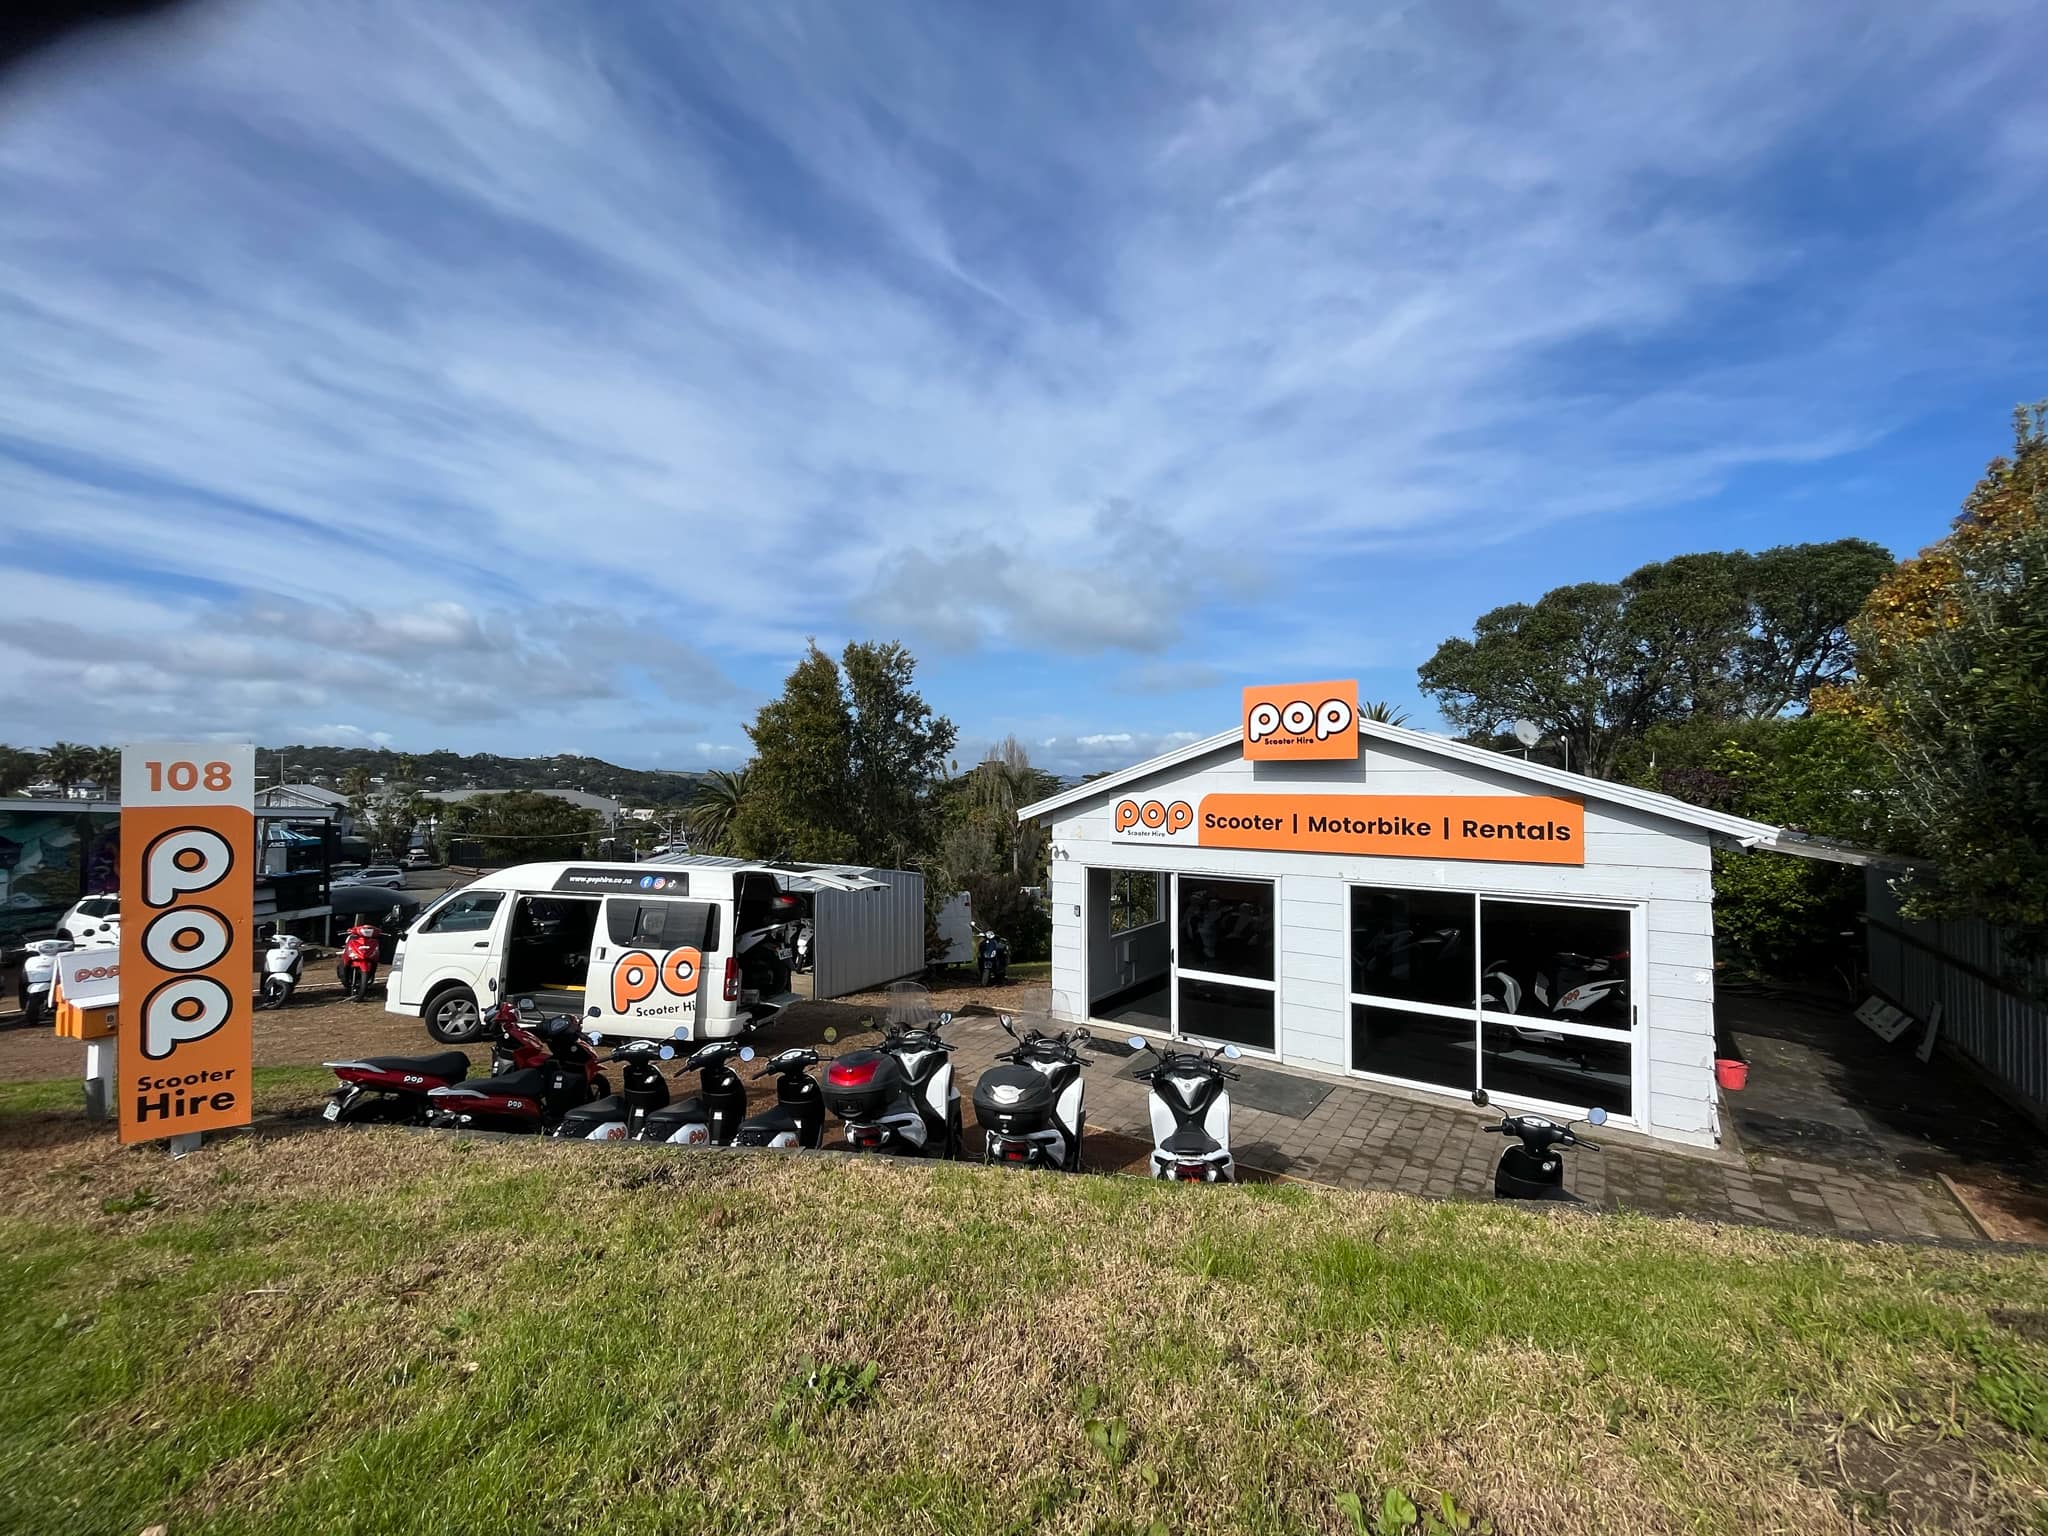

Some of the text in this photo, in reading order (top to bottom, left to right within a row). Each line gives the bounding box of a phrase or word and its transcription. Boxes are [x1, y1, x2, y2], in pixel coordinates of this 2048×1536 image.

[1248, 698, 1352, 743] pop
[1264, 736, 1314, 745] Scooter Hire
[145, 761, 232, 792] 108
[1115, 799, 1194, 835] pop
[1205, 813, 1283, 831] Scooter
[1308, 816, 1431, 836] Motorbike
[1462, 820, 1571, 841] Rentals
[636, 1004, 680, 1017] Scooter
[137, 1068, 236, 1093] Scooter
[403, 1075, 424, 1084] pop
[137, 1088, 236, 1123] Hire
[507, 1100, 523, 1109] pop
